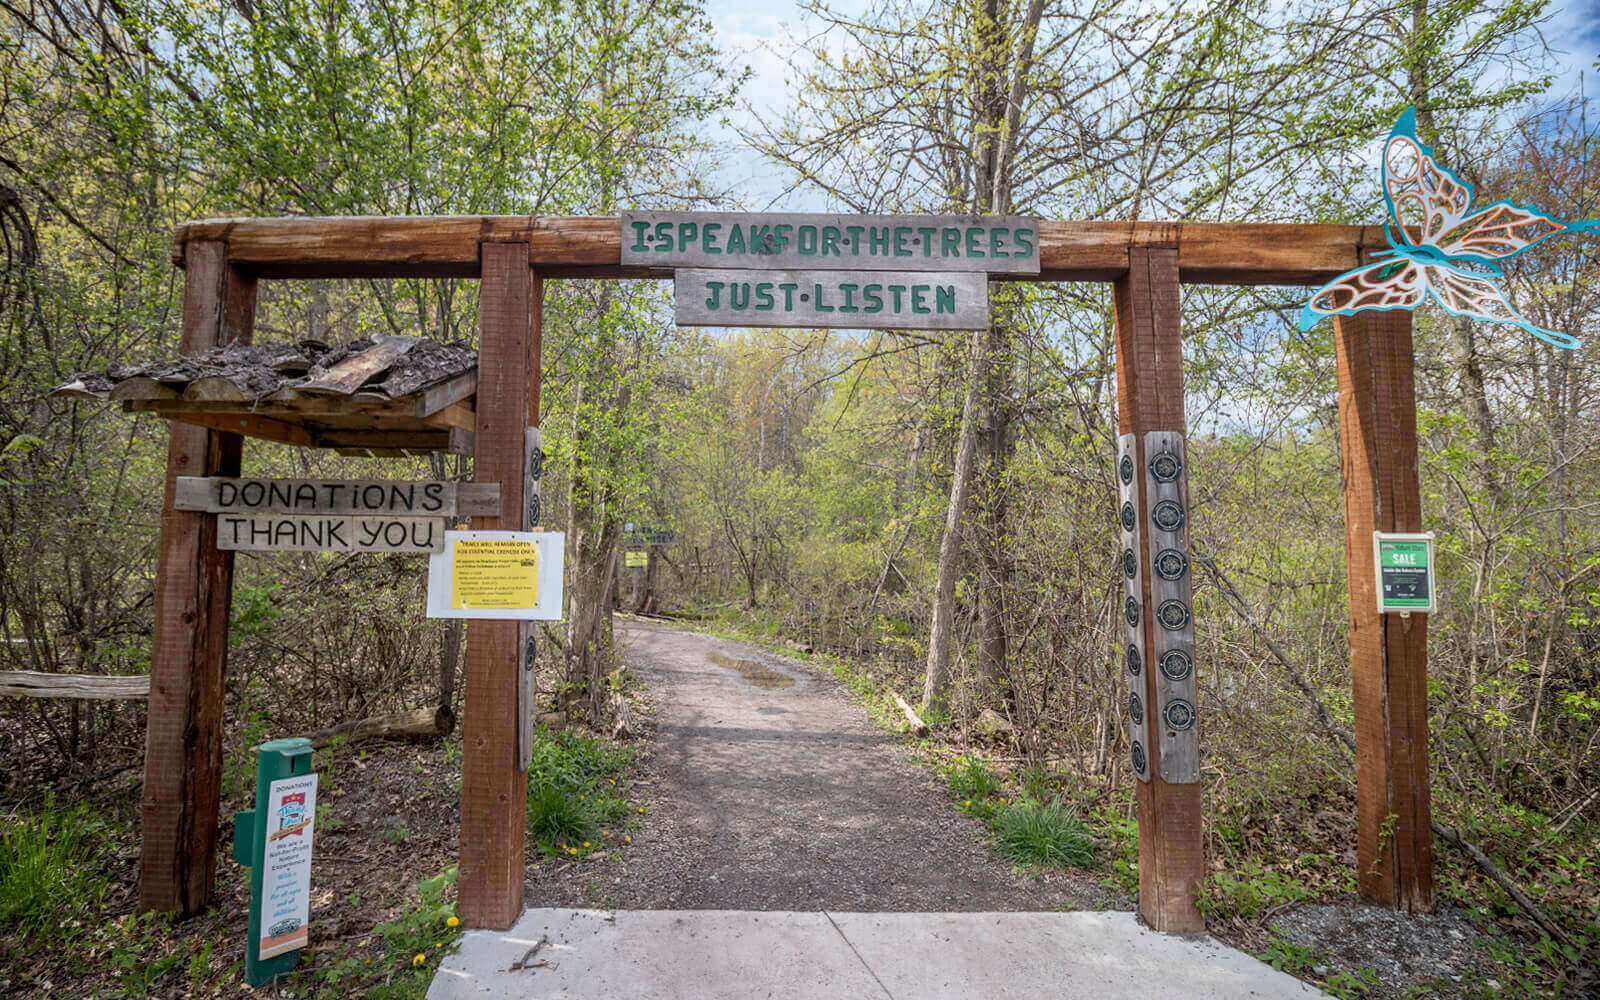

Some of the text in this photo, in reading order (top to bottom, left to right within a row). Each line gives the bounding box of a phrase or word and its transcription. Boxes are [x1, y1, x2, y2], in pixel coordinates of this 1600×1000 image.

[631, 221, 1034, 259] I SPEAK FOR THE TREES
[705, 281, 956, 314] JUST LISTEN
[225, 518, 434, 549] THANK YOU
[1392, 553, 1417, 565] SALE
[275, 781, 313, 792] DONATIONS
